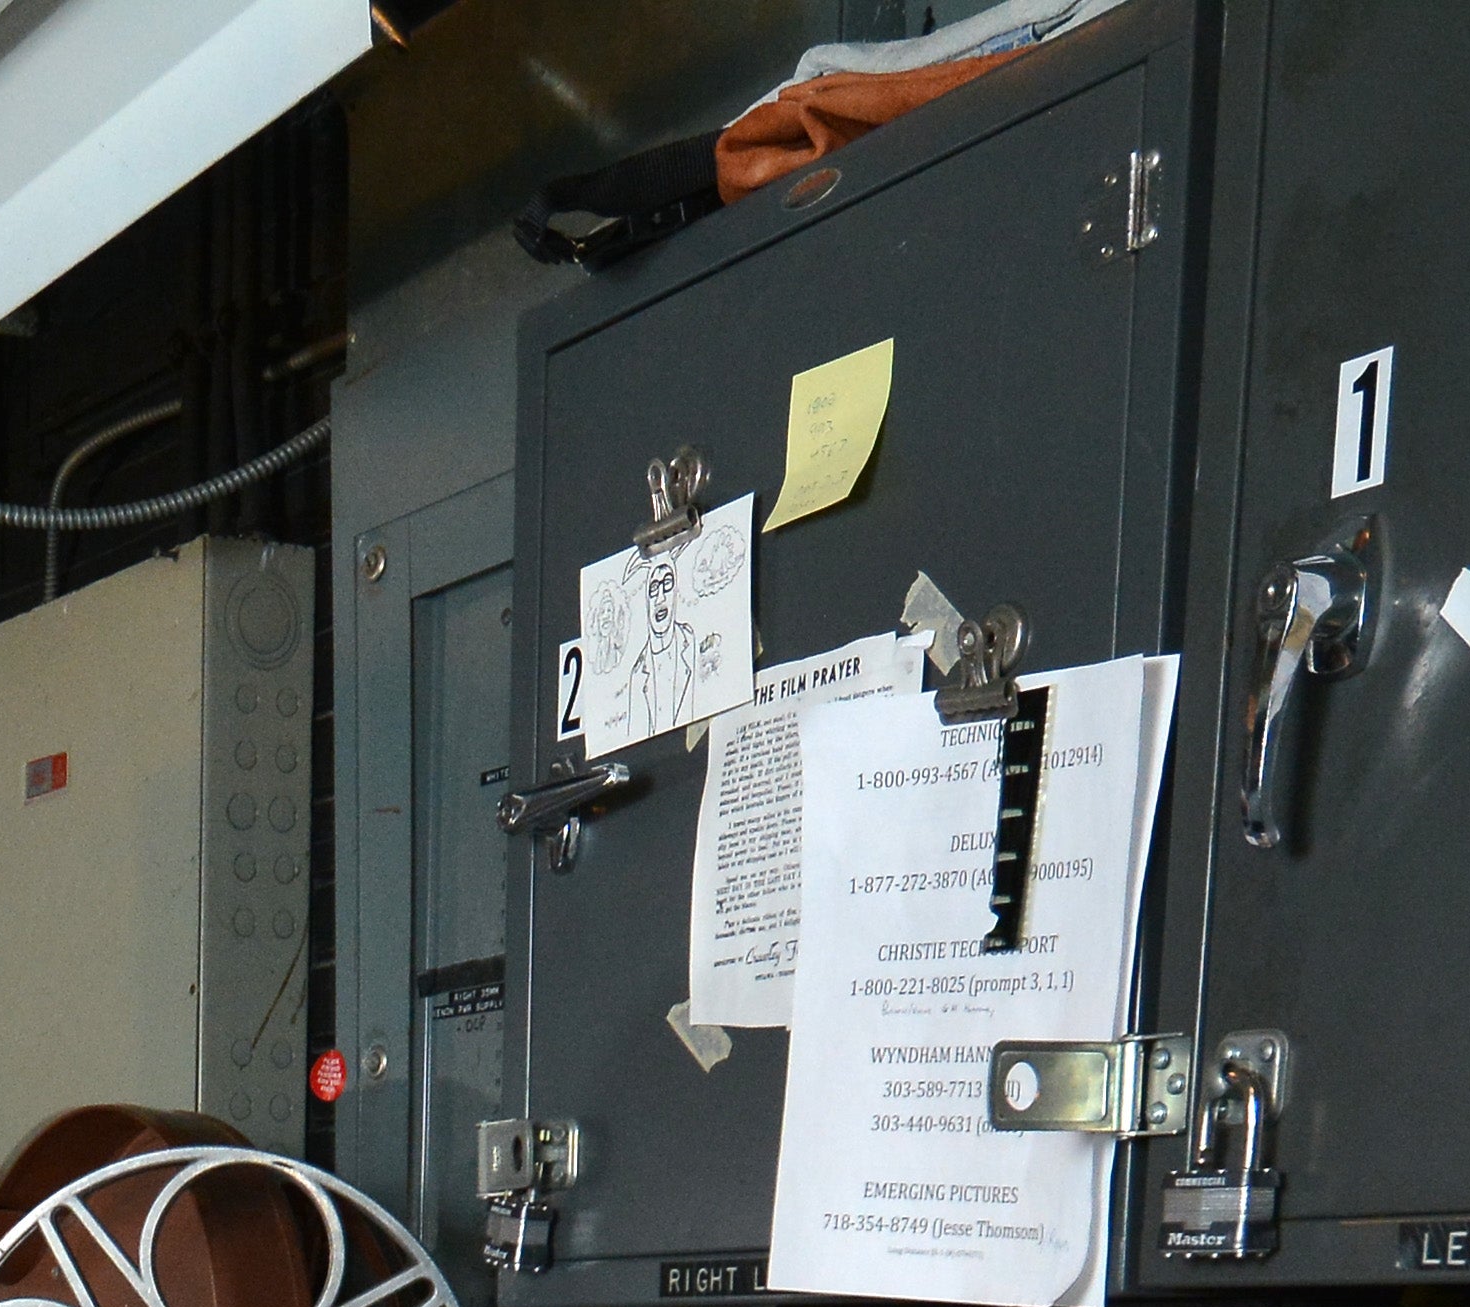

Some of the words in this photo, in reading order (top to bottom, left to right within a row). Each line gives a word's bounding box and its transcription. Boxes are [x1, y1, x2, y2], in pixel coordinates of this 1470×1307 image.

[1352, 359, 1379, 483] 1
[561, 646, 583, 735] 2
[753, 682, 775, 707] THE
[780, 672, 807, 699] FILM
[812, 656, 861, 690] PRAYER
[486, 768, 509, 783] WHITE
[857, 761, 978, 790] 1-800-993-4567
[850, 870, 967, 894] 1-877-272-3870
[877, 942, 946, 962] CHRISTIE
[454, 991, 477, 1001] RIGHT
[850, 975, 965, 996] 1-800-221-8025
[969, 973, 1026, 998] (prompt
[1031, 972, 1043, 993] 3,
[1046, 971, 1058, 993] 1,
[1061, 970, 1075, 992] 1)
[476, 1001, 503, 1012] SUPPLY
[871, 1046, 951, 1064] WYNDHAM
[883, 1080, 982, 1099] 303-589-7713
[871, 1114, 971, 1132] 303-440-9631
[864, 1180, 945, 1202] EMERGING
[949, 1184, 1019, 1204] PICTURES
[824, 1213, 928, 1235] 718-354-8749
[932, 1219, 973, 1239] (Jesse
[1167, 1232, 1227, 1246] Master
[668, 1267, 739, 1293] RIGHT
[753, 1265, 765, 1291] L
